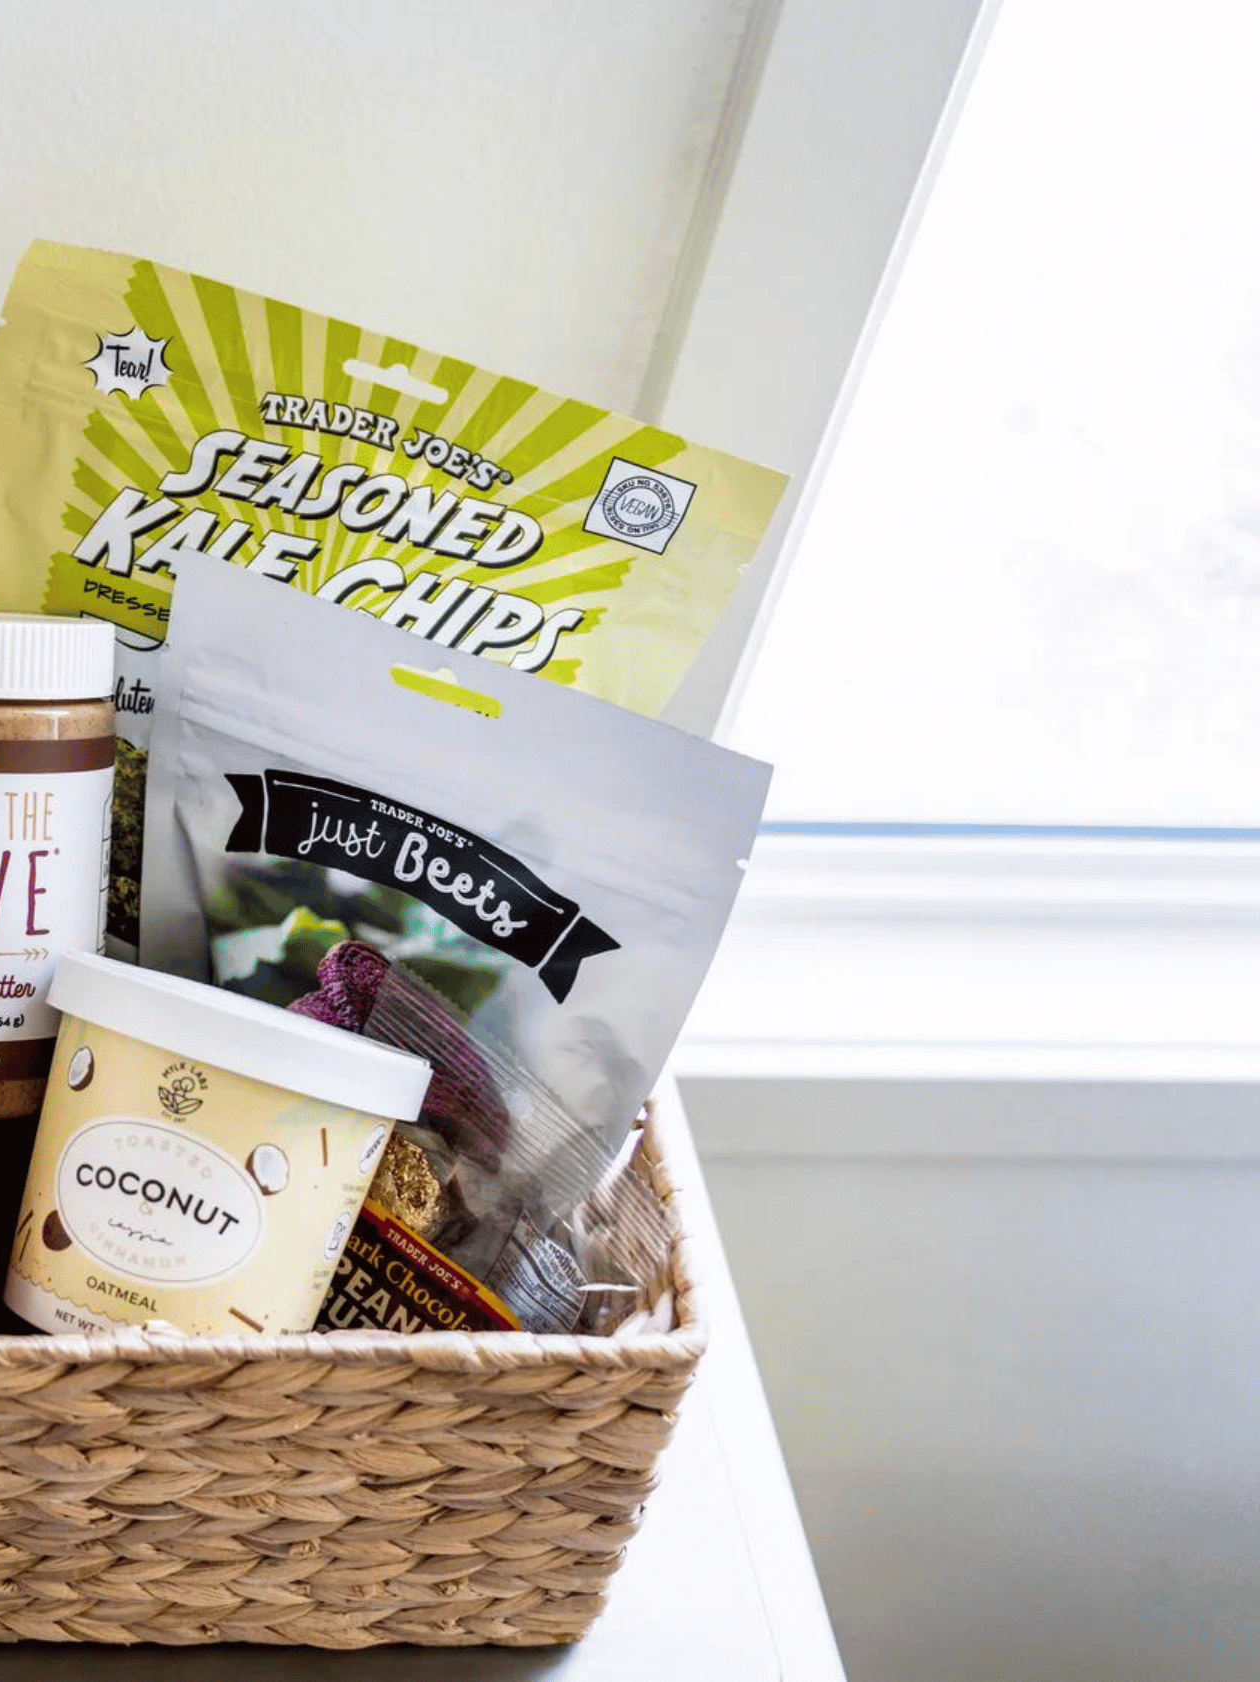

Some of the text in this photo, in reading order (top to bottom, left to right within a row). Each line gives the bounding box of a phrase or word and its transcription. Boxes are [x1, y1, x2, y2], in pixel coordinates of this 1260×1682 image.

[105, 344, 154, 383] Tear!
[259, 391, 399, 451] TRADER
[158, 429, 544, 569] SEASONED
[620, 496, 660, 520] VEGAN
[83, 578, 170, 622] DRESSE
[111, 675, 155, 714] luten
[4, 791, 54, 841] THE
[369, 799, 424, 829] TRADER
[298, 801, 528, 937] just Beets
[13, 1013, 25, 1028] g)
[76, 1163, 240, 1235] COCONUT
[347, 1235, 385, 1269] ark
[386, 1228, 429, 1266] TRADER
[86, 1276, 158, 1313] OATMEAL
[55, 1308, 76, 1324] NET
